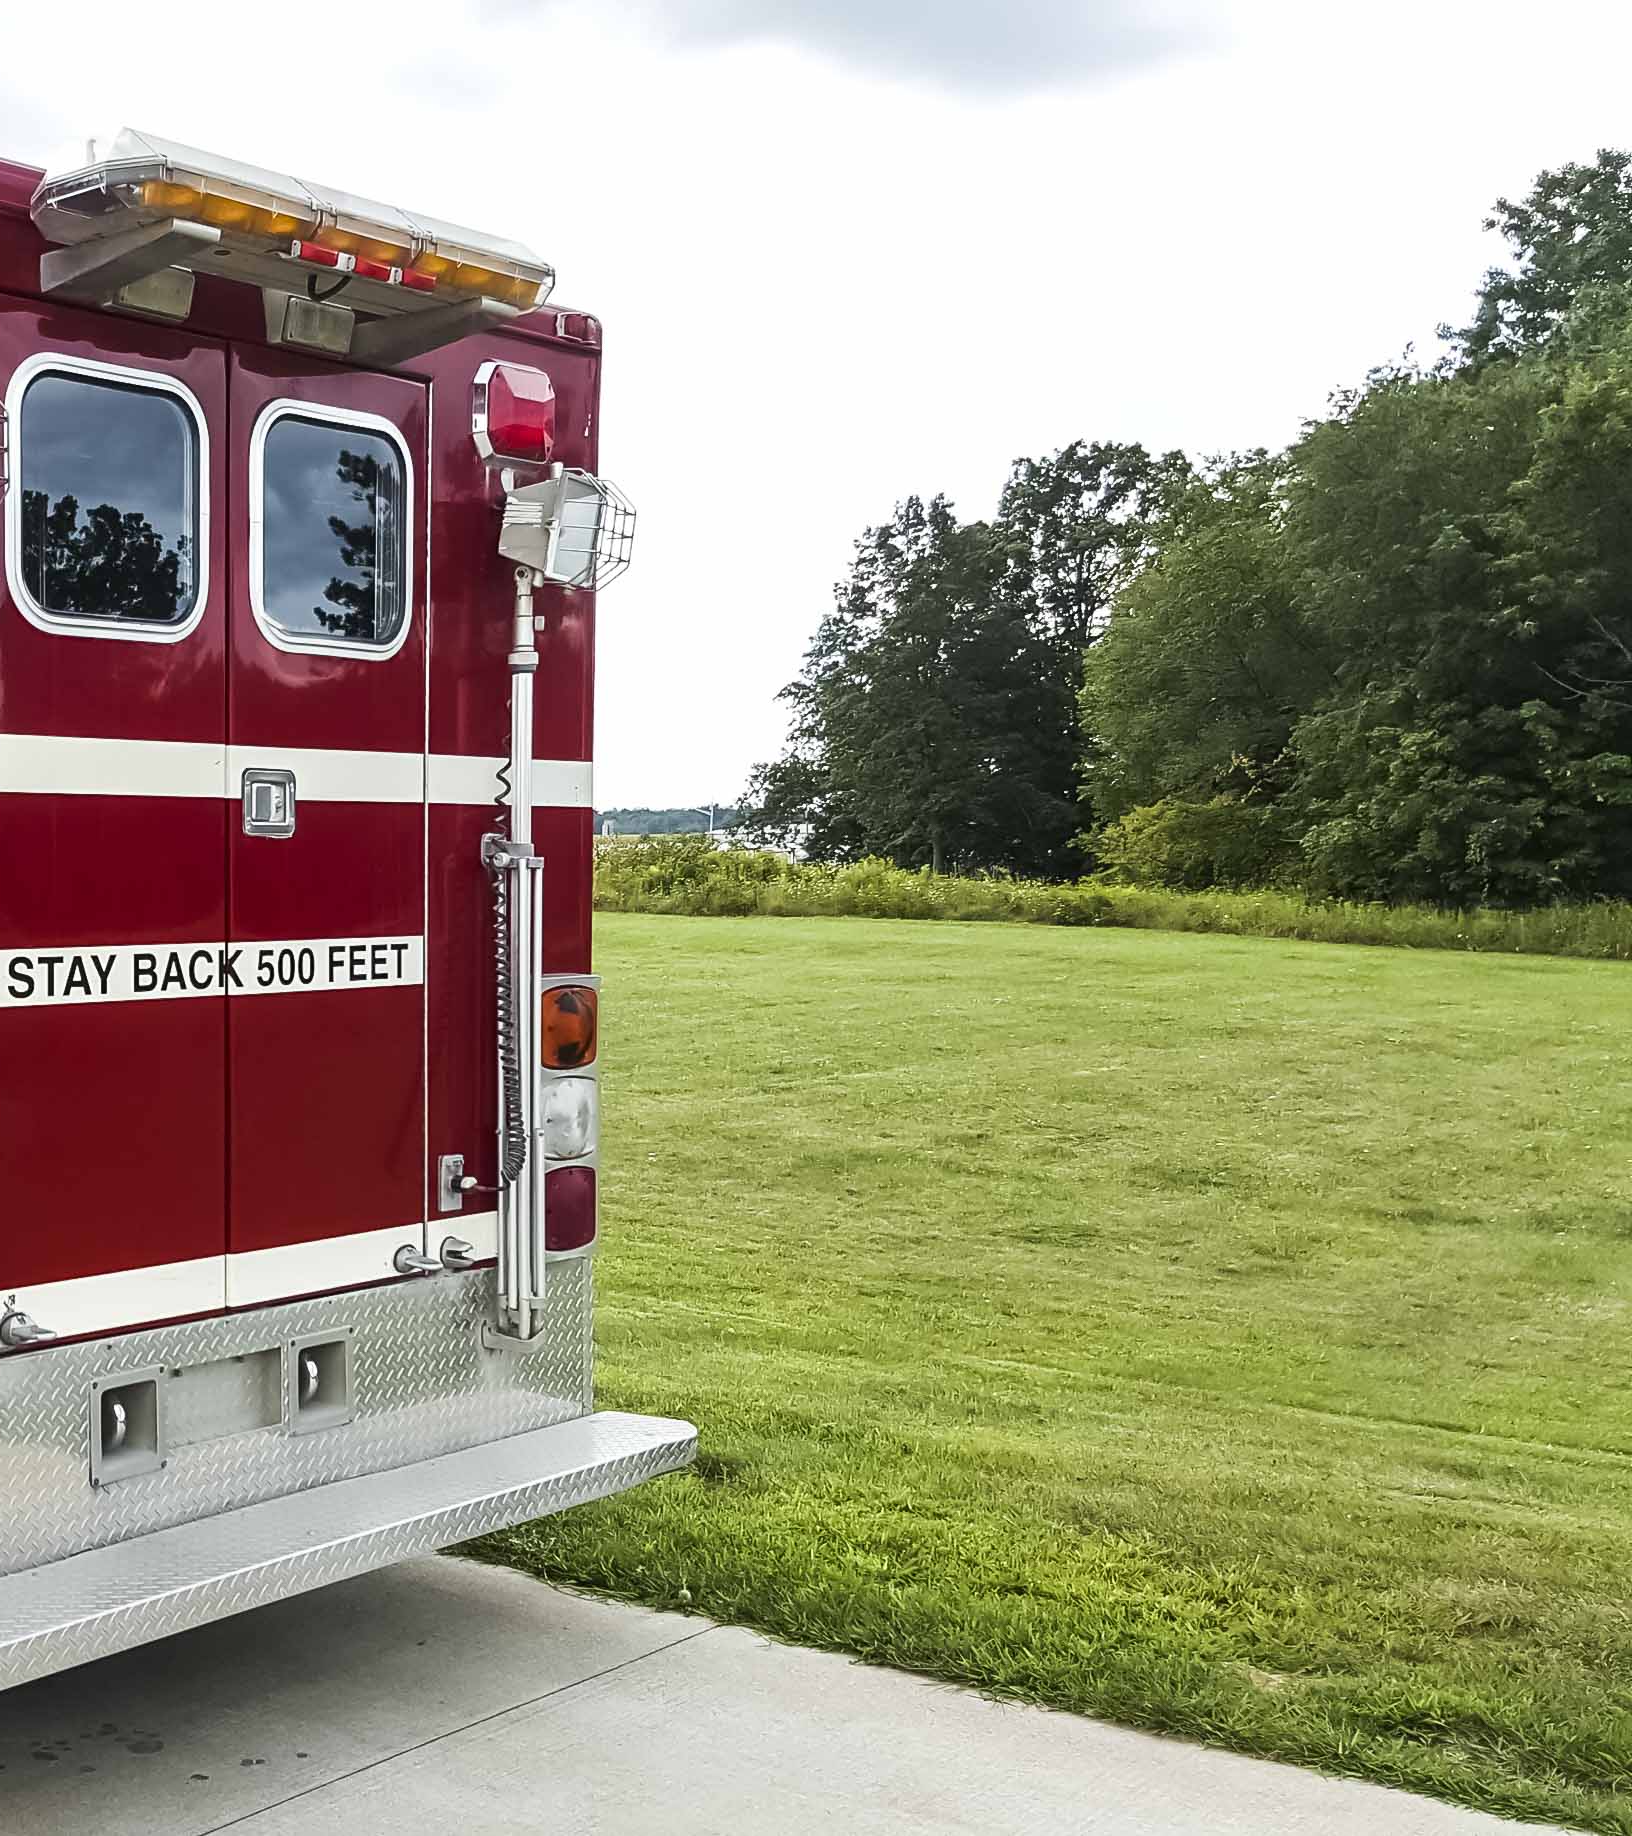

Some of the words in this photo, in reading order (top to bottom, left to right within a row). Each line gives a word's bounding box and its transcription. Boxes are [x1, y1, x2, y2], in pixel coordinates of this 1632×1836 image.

[7, 954, 117, 998] STAY
[132, 949, 244, 992] BACK
[256, 947, 316, 986] 500
[327, 943, 410, 982] FEET
